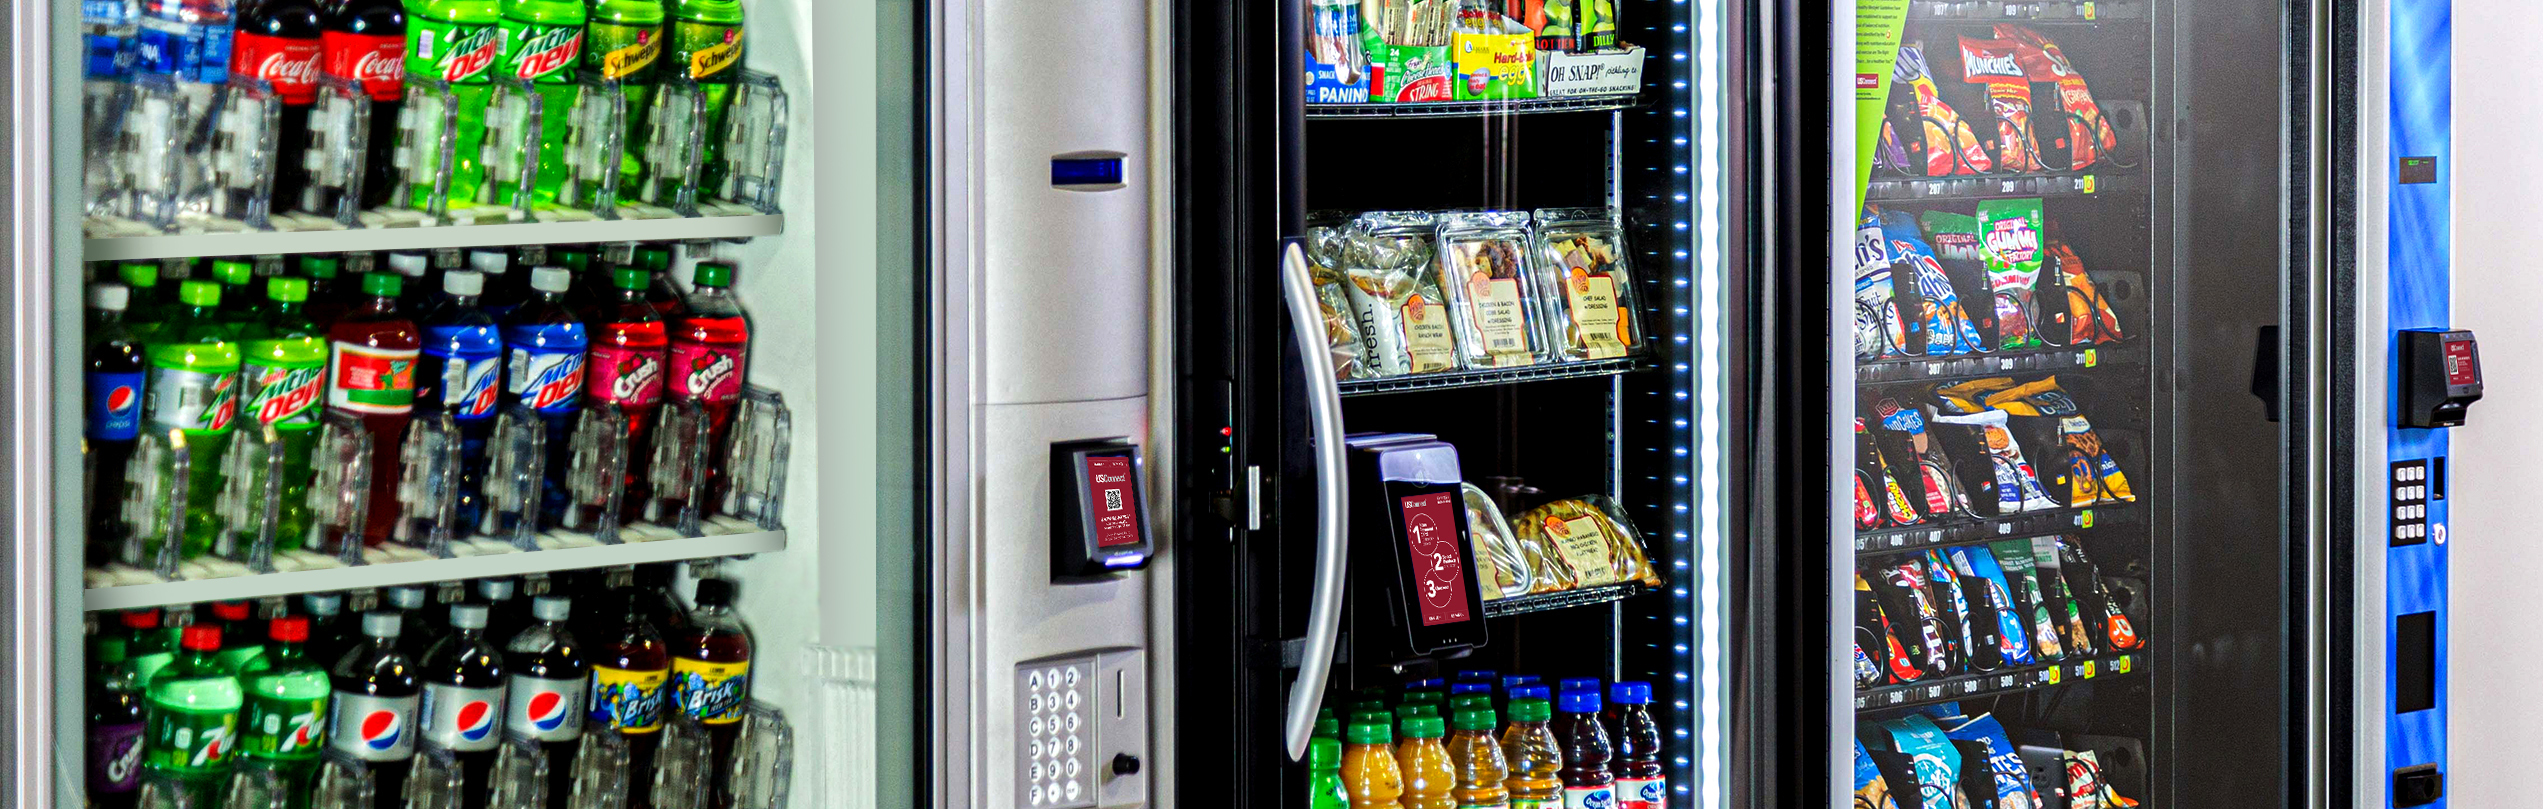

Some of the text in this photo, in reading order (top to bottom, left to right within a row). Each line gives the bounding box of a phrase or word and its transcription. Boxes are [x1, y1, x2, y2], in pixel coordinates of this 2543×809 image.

[2005, 5, 2017, 16] 109
[1593, 33, 1615, 47] DILLY
[1390, 48, 1400, 56] 24
[1962, 44, 2024, 79] MUNCHIES
[1318, 70, 1336, 79] SNACK
[1551, 66, 1565, 82] OH
[1605, 65, 1630, 78] pickling
[1320, 86, 1368, 102] PANINO
[1410, 83, 1439, 102] STRING
[1928, 183, 1941, 194] 207
[2002, 181, 2014, 192] 209
[2074, 178, 2083, 190] 211
[1935, 233, 1977, 243] ORIGINAL
[1986, 229, 2038, 251] GUMMI
[2008, 250, 2033, 263] FACTORY
[1928, 363, 1940, 375] 307
[2000, 358, 2013, 370] 309
[613, 357, 659, 399] Crush
[687, 354, 734, 395] Crush
[105, 420, 131, 430] pepsi
[1413, 526, 1421, 543] 1
[1998, 522, 2011, 535] 409
[1890, 534, 1903, 546] 406
[1928, 531, 1941, 542] 407
[1856, 539, 1865, 550] 05
[1433, 553, 1444, 570] 2
[1426, 580, 1436, 598] 3
[2075, 664, 2085, 676] 511
[2109, 660, 2120, 671] 512
[1030, 676, 1038, 688] A
[1050, 674, 1055, 684] 1
[1068, 672, 1074, 684] 2
[2000, 675, 2013, 688] 509
[2039, 670, 2049, 682] 510
[1929, 686, 1941, 698] 507
[1964, 680, 1977, 692] 508
[687, 682, 734, 712] Brisk
[1050, 696, 1056, 709] 3
[1068, 694, 1073, 706] 4
[1890, 691, 1903, 703] 506
[1030, 698, 1038, 710] B
[1856, 698, 1865, 709] 05
[1030, 721, 1038, 734] C
[1050, 719, 1056, 731] 5
[1068, 717, 1074, 729] 6
[1030, 744, 1038, 756] D
[1050, 741, 1056, 754] 7
[1068, 739, 1073, 752] 8
[1030, 767, 1037, 779] E
[1050, 764, 1056, 777] 9
[1068, 762, 1073, 774] 0
[1031, 789, 1037, 802] F
